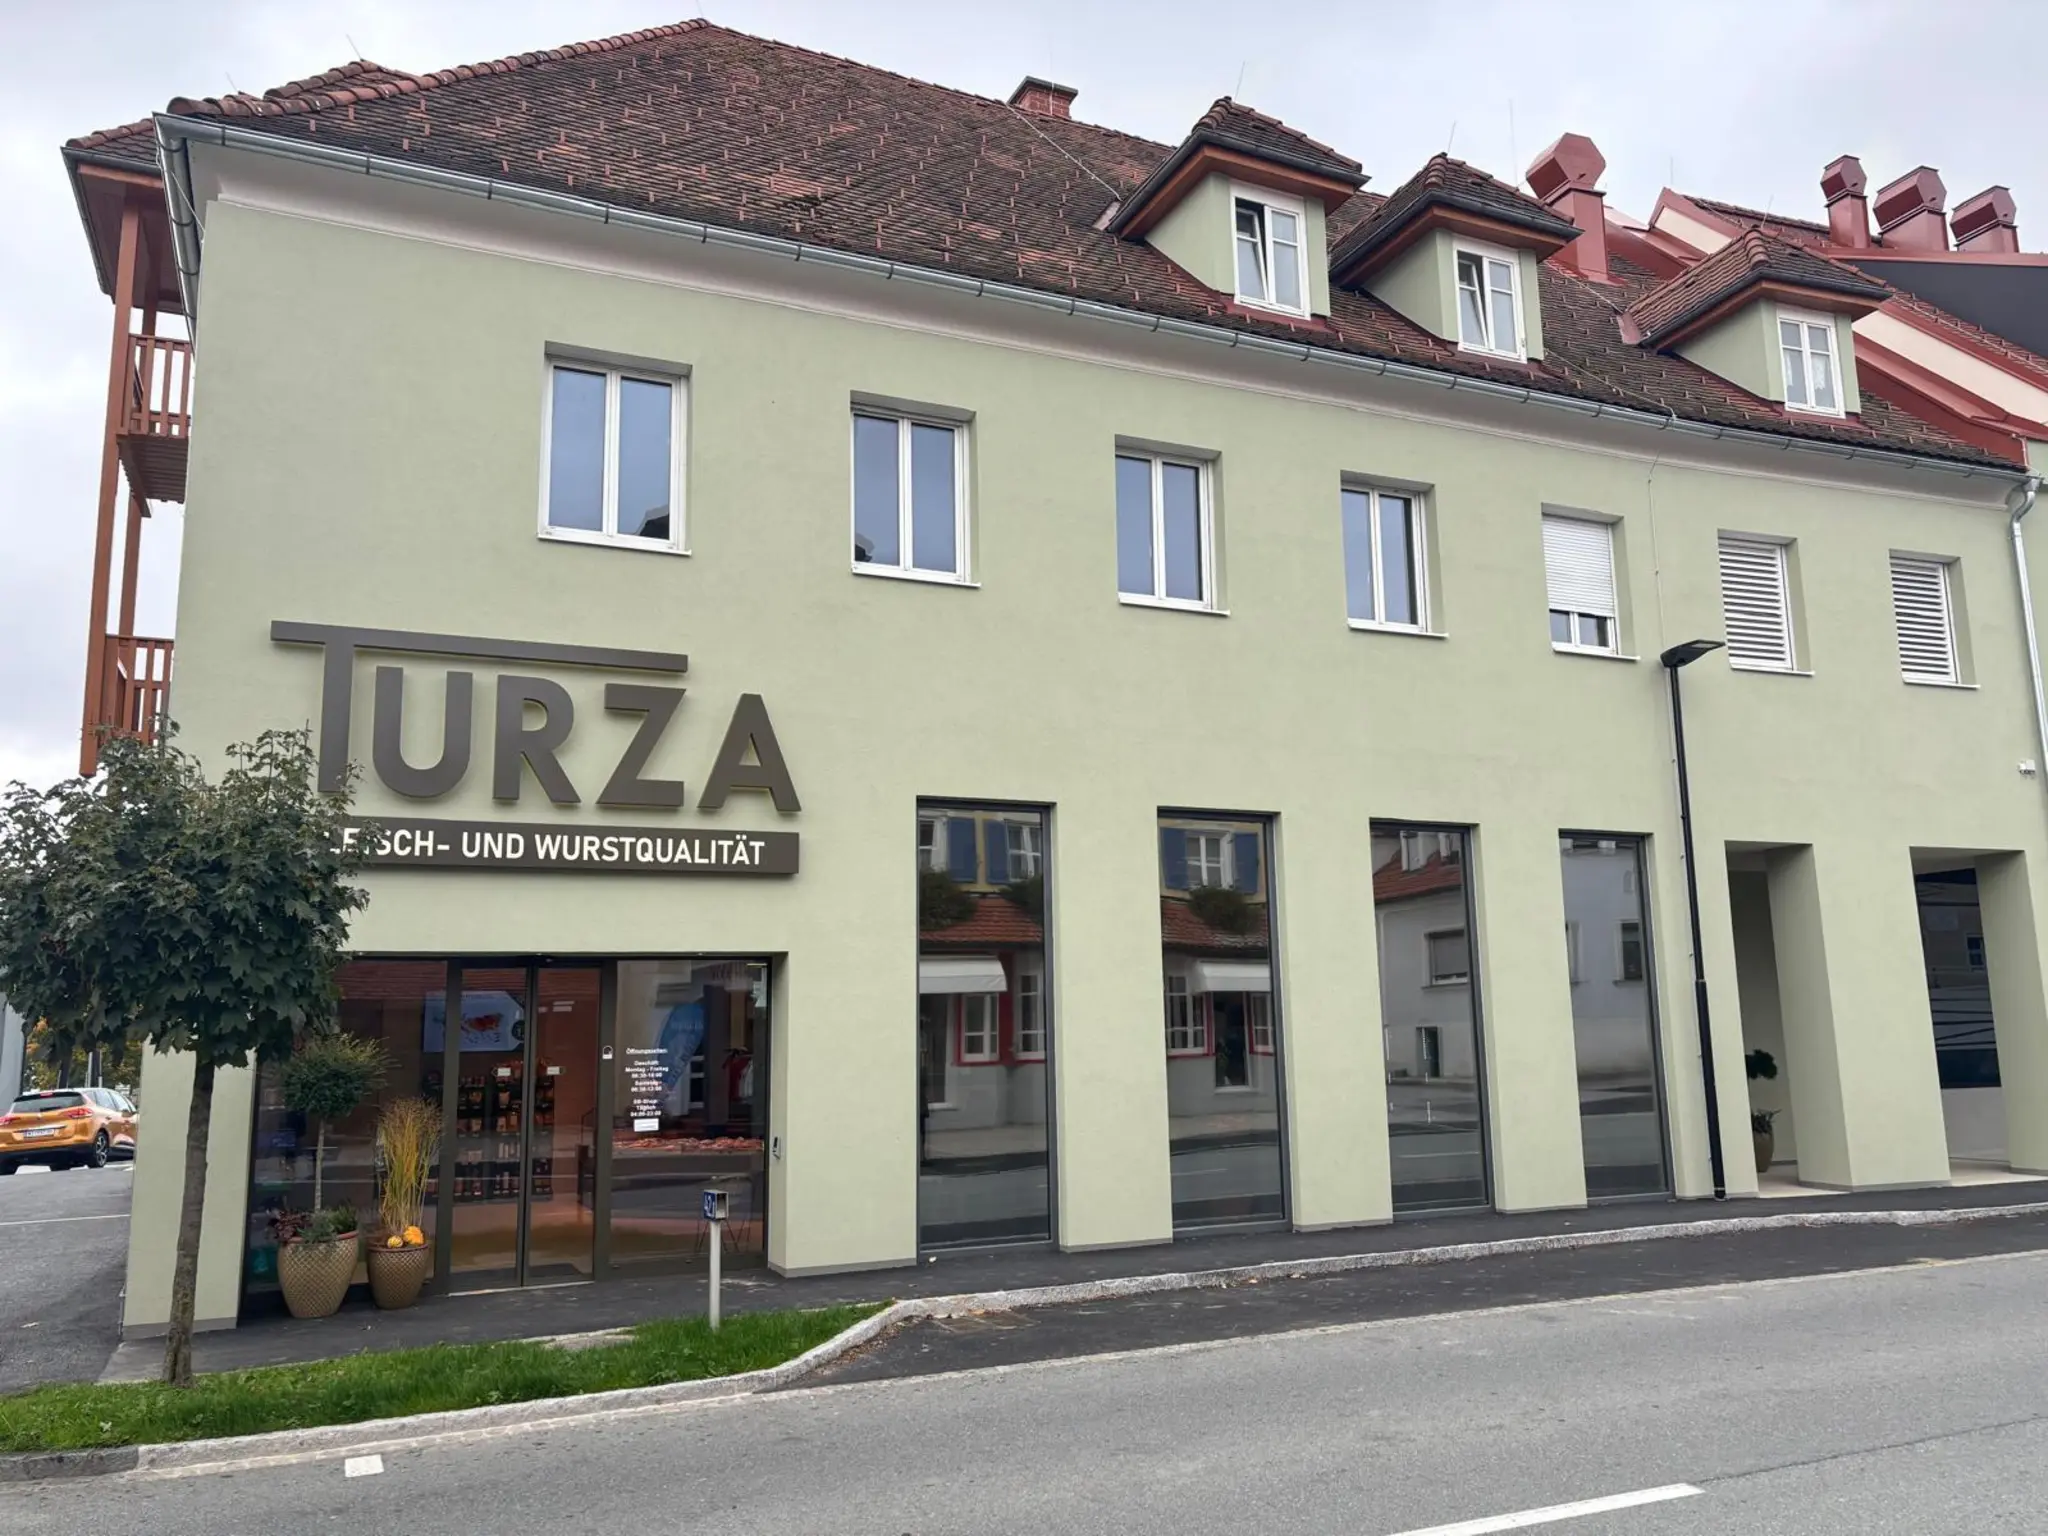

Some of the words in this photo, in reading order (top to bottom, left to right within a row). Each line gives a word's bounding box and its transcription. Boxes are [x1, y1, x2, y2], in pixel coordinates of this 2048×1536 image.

[270, 620, 802, 812] TURZA
[322, 827, 450, 857] ESCH-
[461, 831, 525, 859] UND
[534, 834, 765, 866] WURSTQUALITÄT
